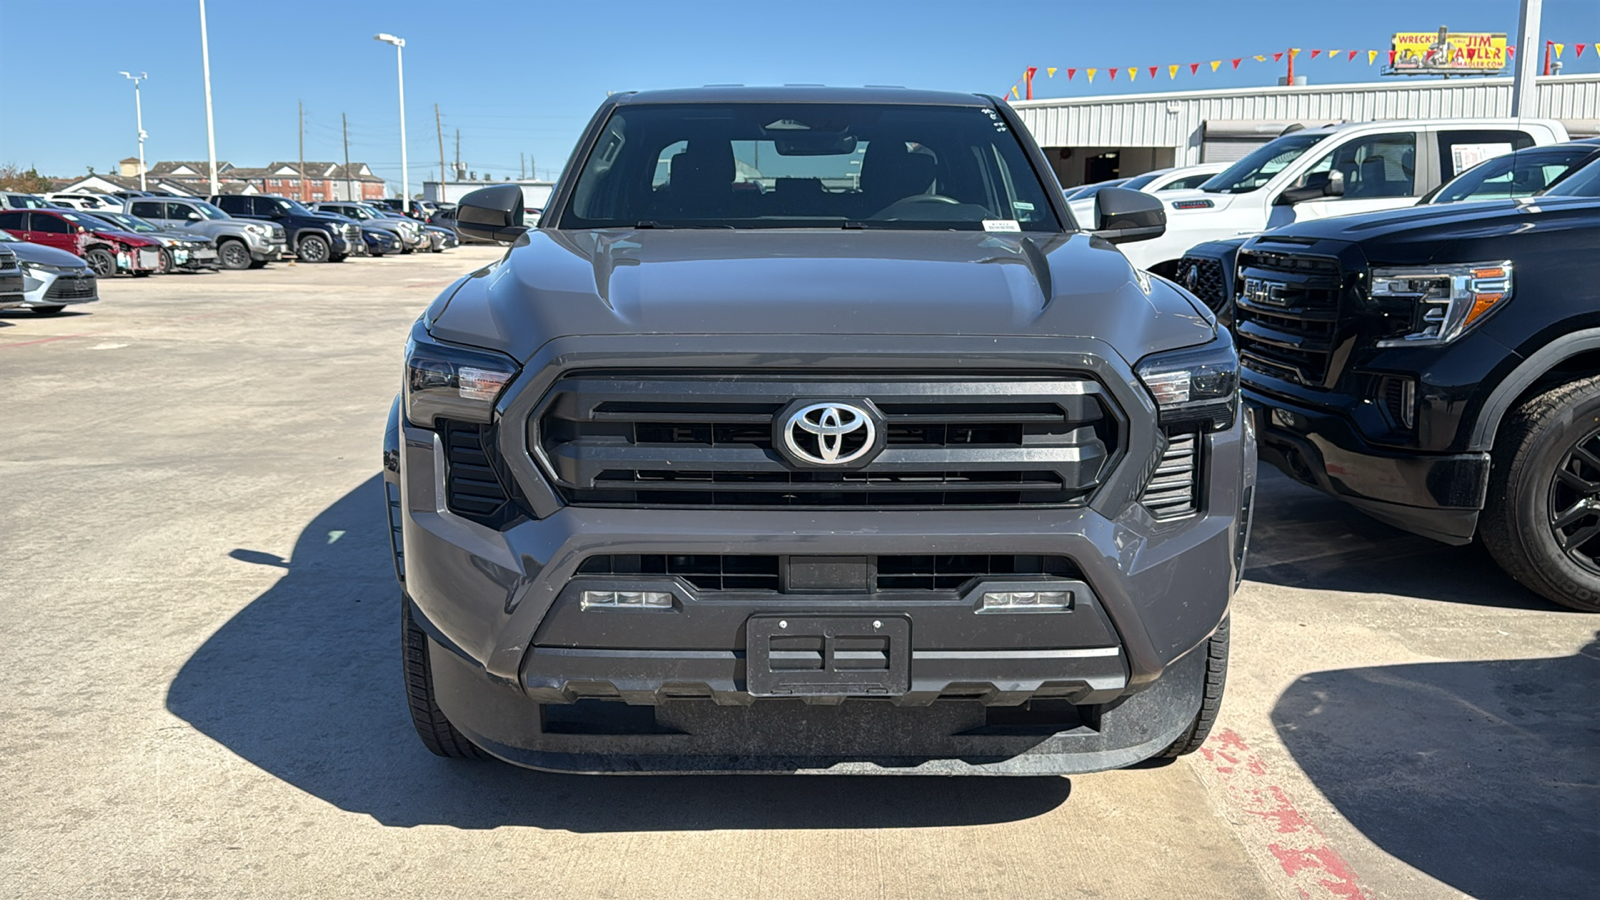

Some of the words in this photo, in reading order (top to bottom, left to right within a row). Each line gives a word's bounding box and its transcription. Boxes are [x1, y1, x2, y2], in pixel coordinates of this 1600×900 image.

[1398, 35, 1437, 44] WRECK?
[1465, 35, 1492, 47] JIM
[1454, 47, 1501, 59] ALER
[1244, 278, 1287, 306] GMC
